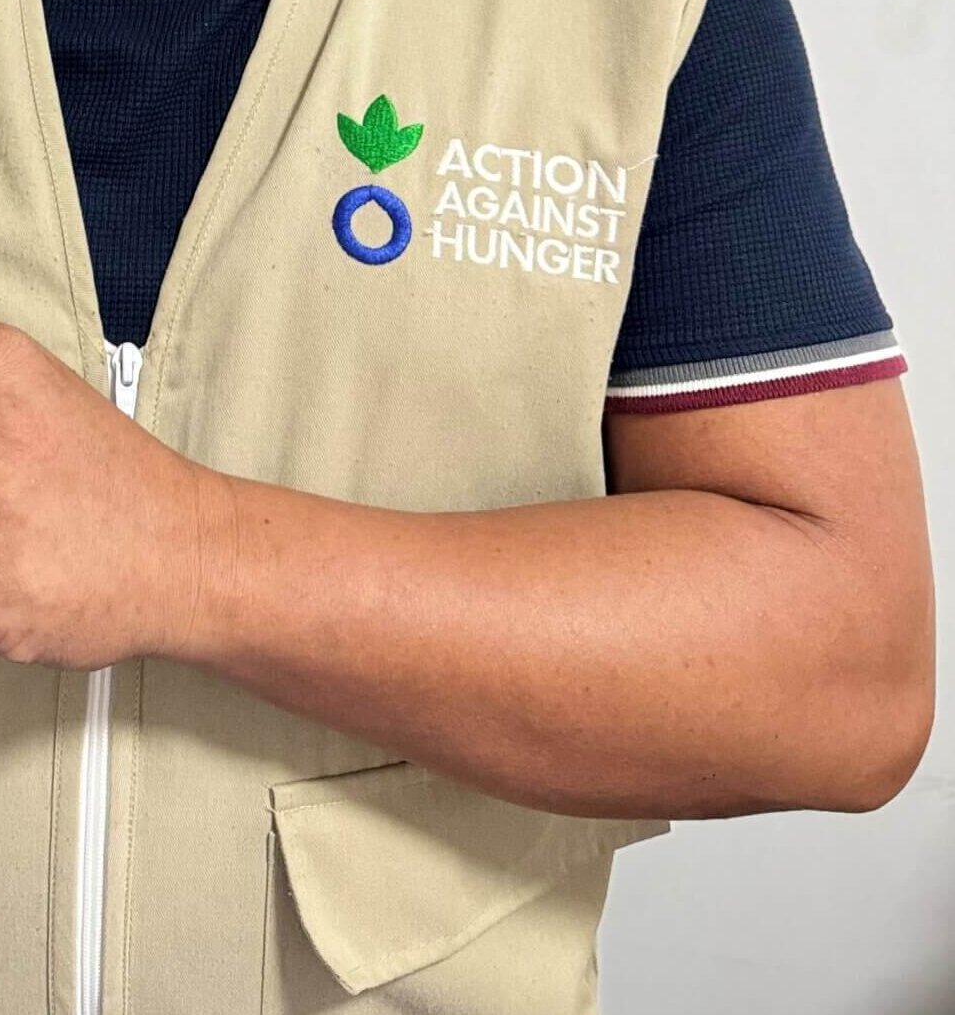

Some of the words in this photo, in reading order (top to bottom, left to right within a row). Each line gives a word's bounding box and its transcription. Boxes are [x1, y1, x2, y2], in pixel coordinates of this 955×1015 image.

[435, 137, 627, 204] ACTION
[434, 180, 627, 244] AGAINST
[430, 220, 621, 285] HUNGER
